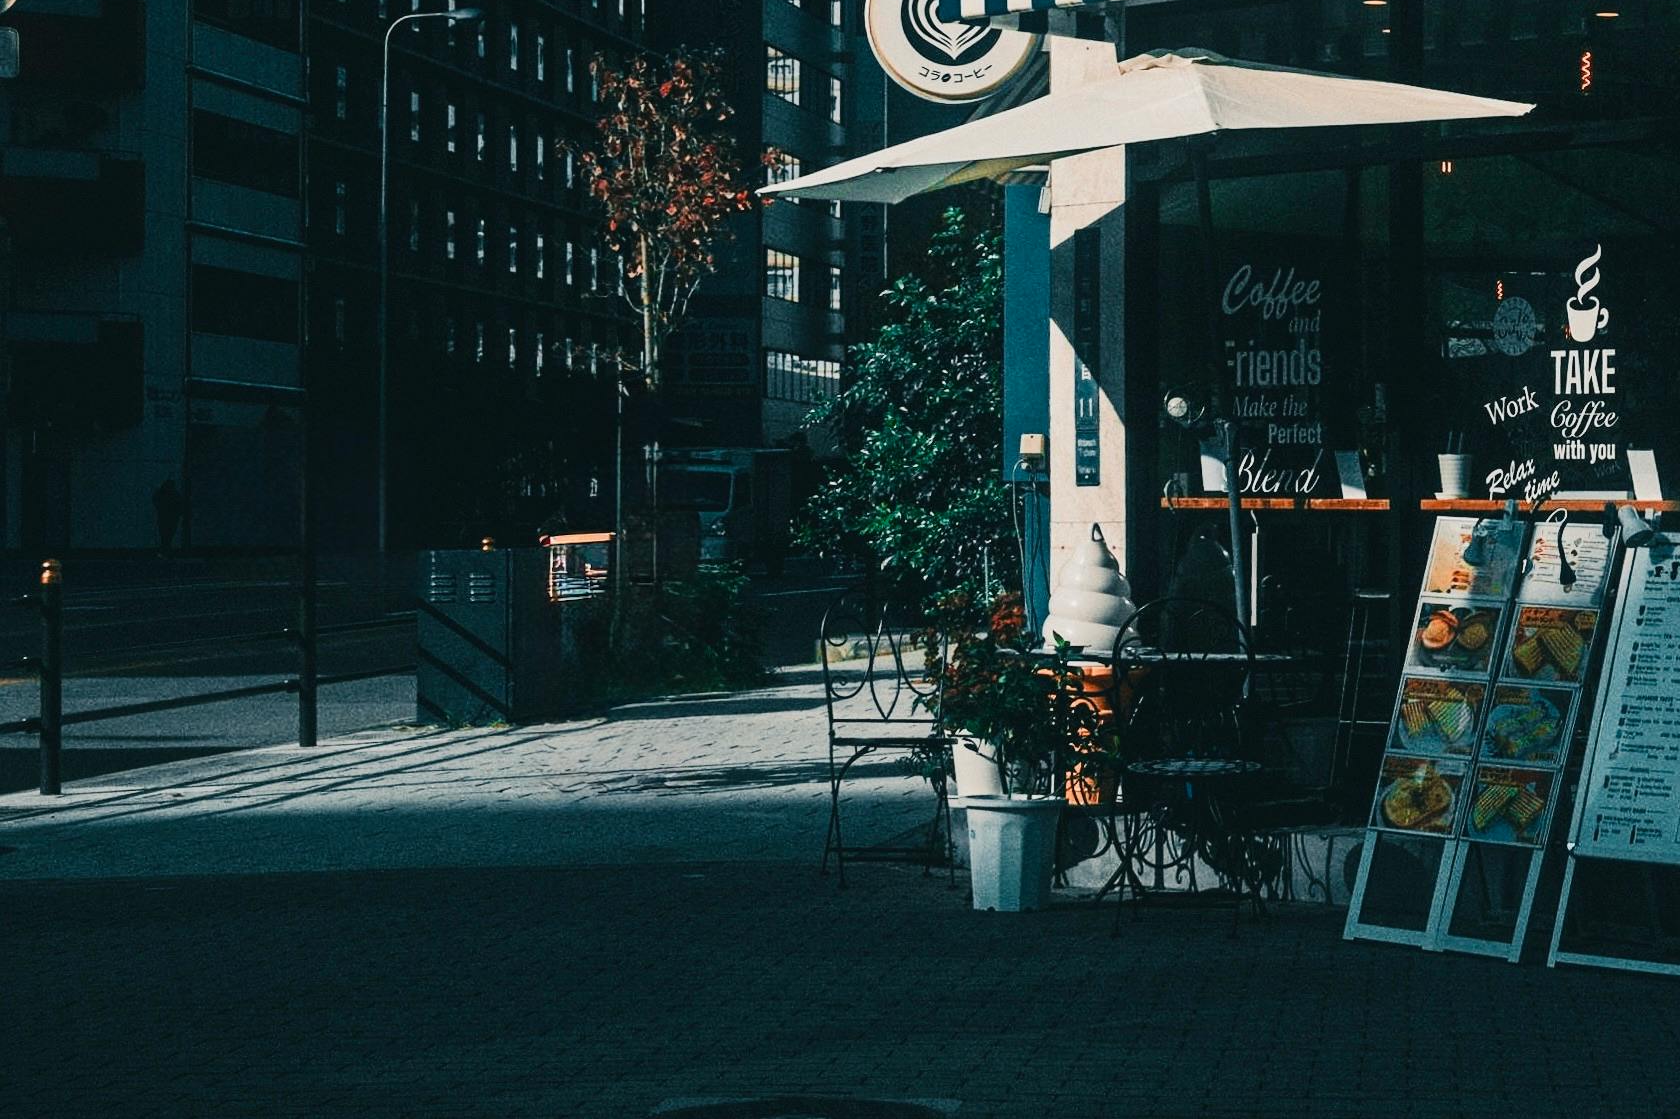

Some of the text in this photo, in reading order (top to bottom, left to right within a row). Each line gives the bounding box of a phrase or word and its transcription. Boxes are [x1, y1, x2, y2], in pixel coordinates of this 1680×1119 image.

[1222, 264, 1321, 320] Coffee
[1288, 309, 1321, 333] and
[1550, 349, 1615, 395] TAKE
[1232, 394, 1307, 417] Make the
[1484, 386, 1539, 425] Work
[1550, 400, 1619, 438] Coffee
[1268, 423, 1323, 444] Perfect
[1553, 440, 1615, 464] with you
[1238, 448, 1324, 493] Blend
[1485, 458, 1535, 501] Relax
[1524, 470, 1560, 503] time
